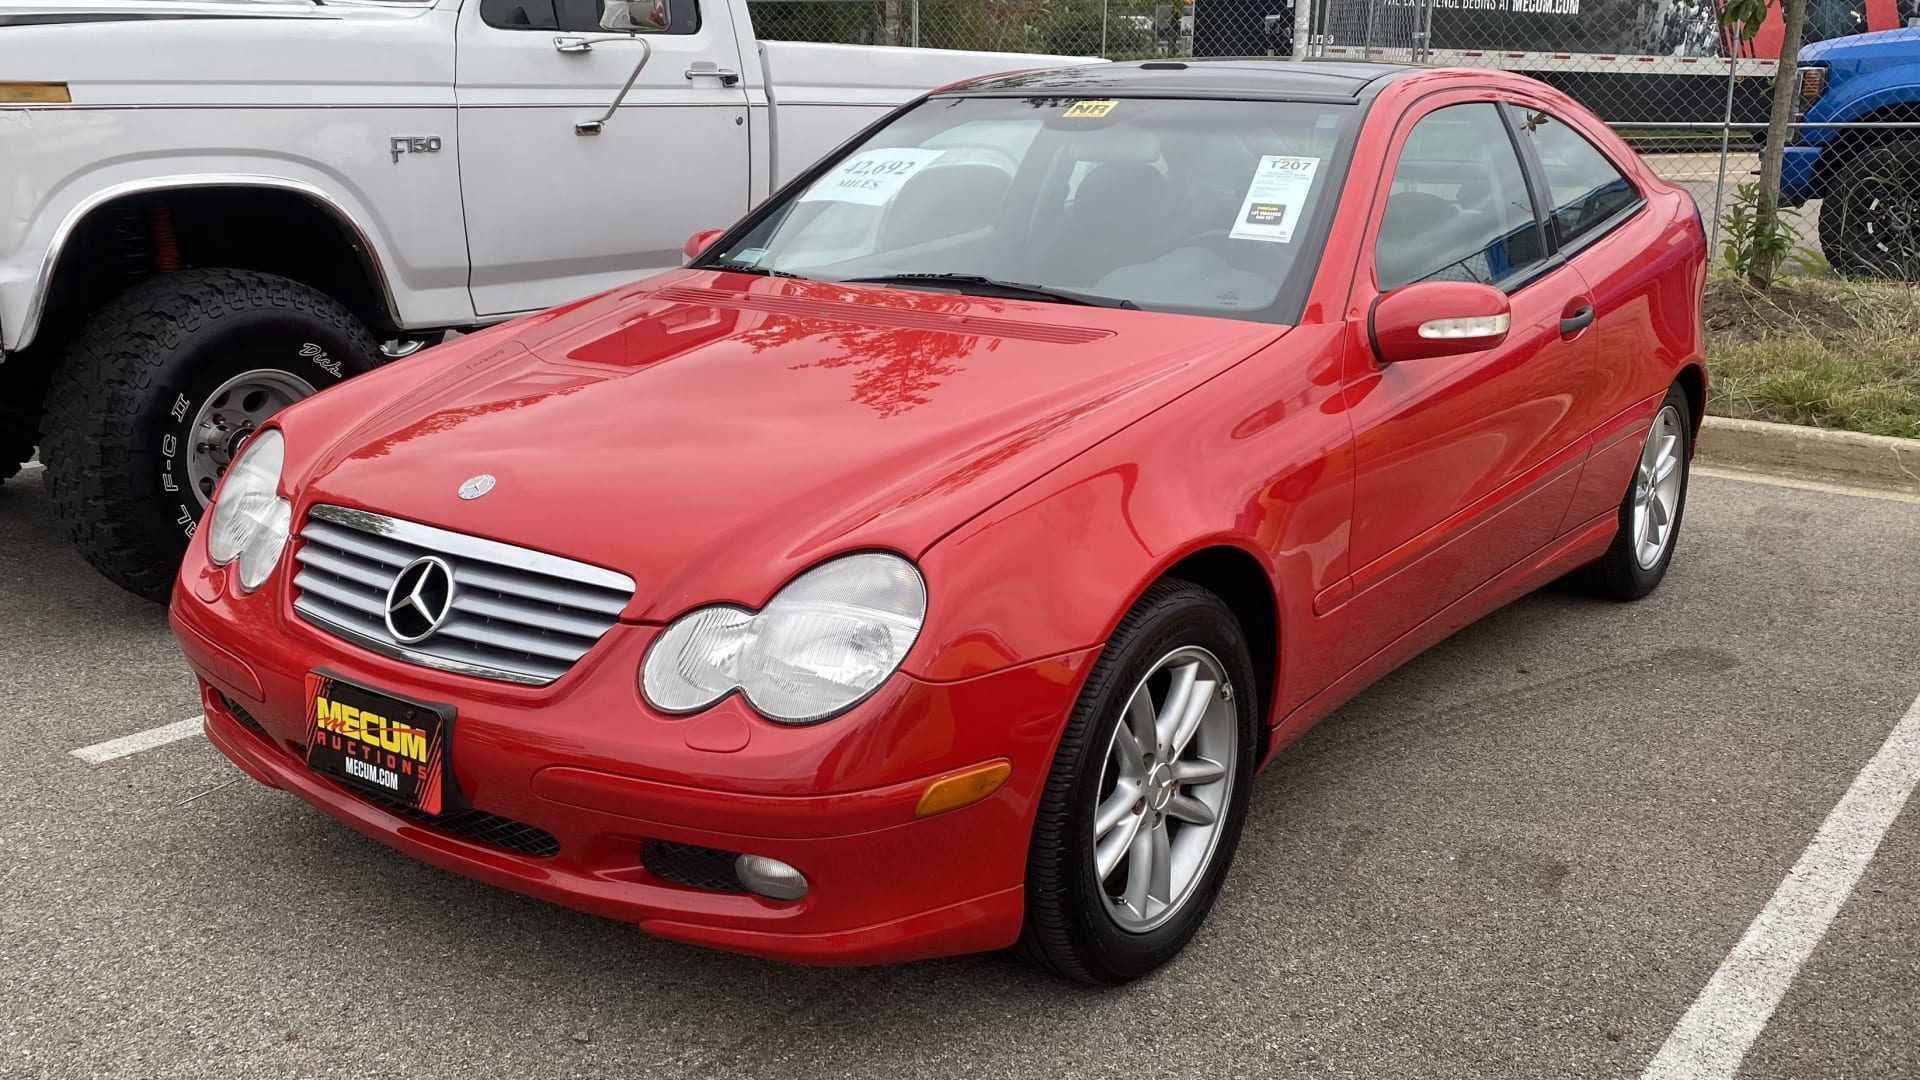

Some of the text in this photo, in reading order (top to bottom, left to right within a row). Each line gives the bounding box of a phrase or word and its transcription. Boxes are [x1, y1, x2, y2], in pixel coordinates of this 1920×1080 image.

[1512, 0, 1579, 14] MECUM.COM
[1070, 104, 1110, 114] NR
[390, 136, 441, 163] F150
[844, 160, 916, 175] 42,692
[1270, 160, 1312, 171] T207
[838, 179, 883, 189] MILES
[299, 342, 342, 378] Dick
[317, 696, 427, 763] MECUM
[317, 732, 428, 781] AUCTIONS
[345, 756, 398, 790] MECUM.COM
